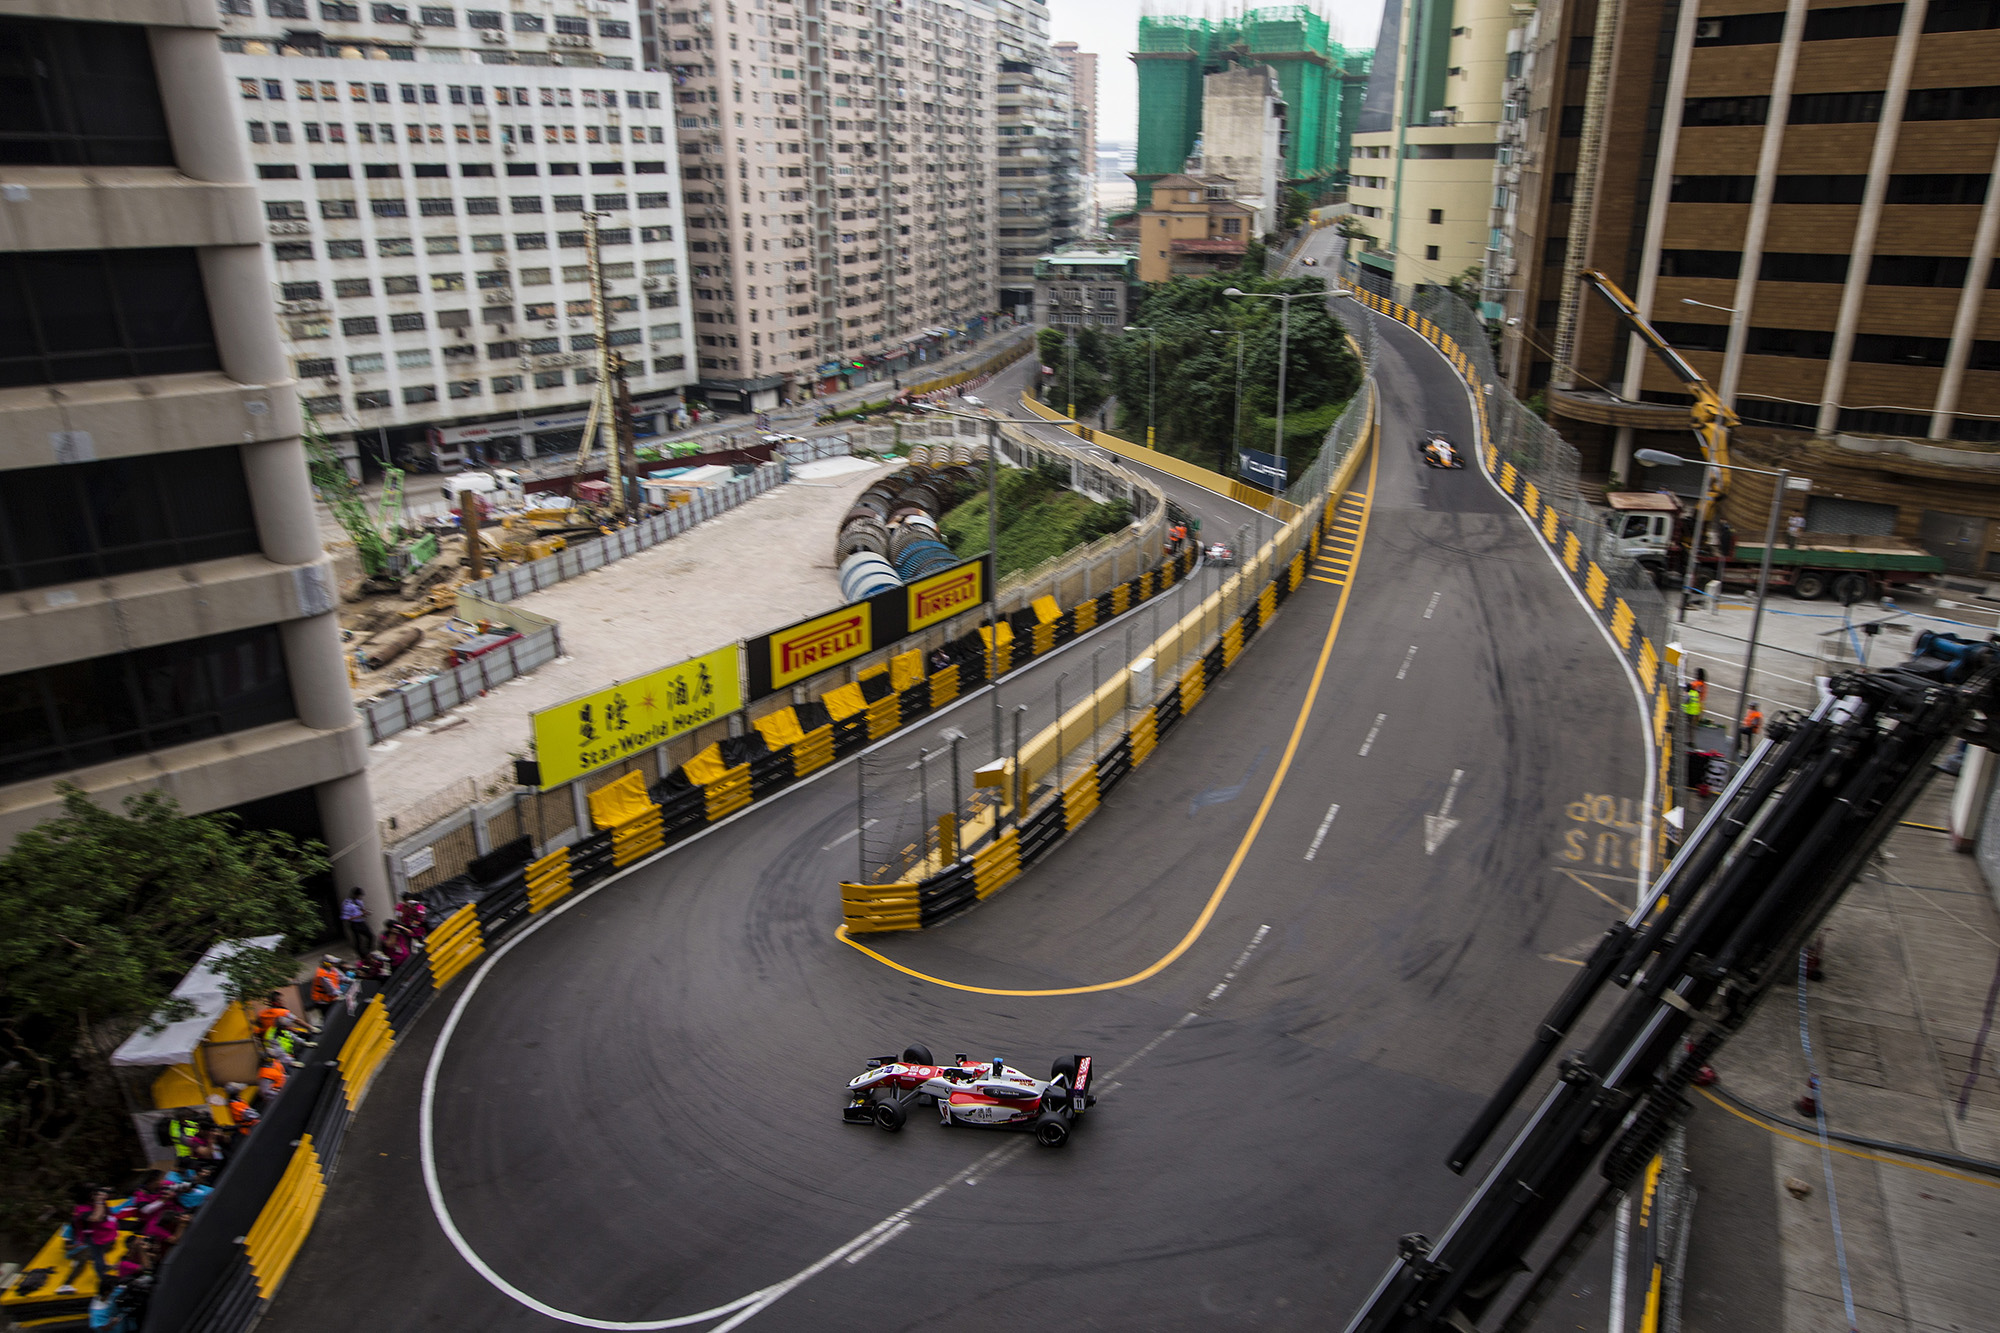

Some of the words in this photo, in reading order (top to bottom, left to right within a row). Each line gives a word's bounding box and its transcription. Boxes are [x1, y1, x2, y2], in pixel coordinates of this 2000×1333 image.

[914, 572, 975, 619] PIRELLI
[780, 615, 862, 674] PIRELLI
[579, 743, 618, 769] Star
[618, 720, 669, 752] World
[671, 702, 715, 731] Hotel
